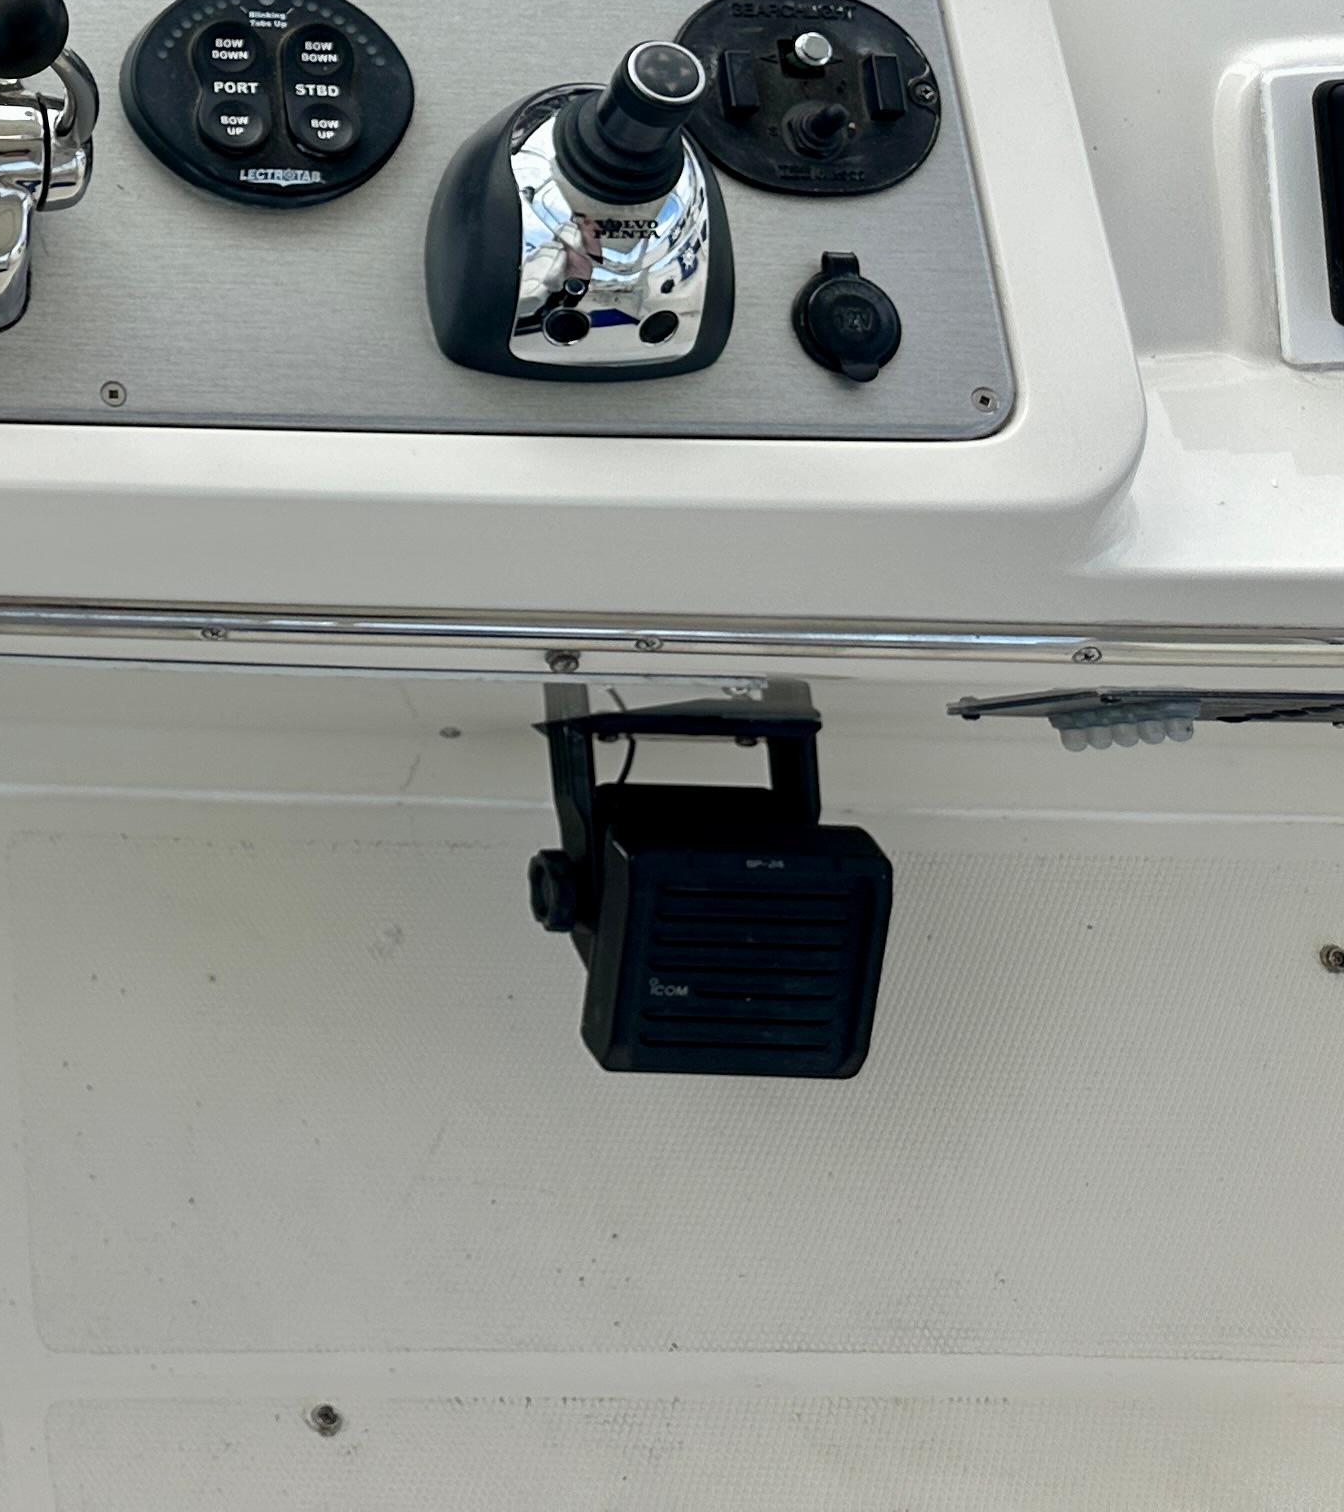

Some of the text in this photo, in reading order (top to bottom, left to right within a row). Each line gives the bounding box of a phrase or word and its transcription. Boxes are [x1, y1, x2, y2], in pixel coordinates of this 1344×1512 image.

[248, 11, 286, 21] Blinking
[274, 20, 288, 31] Up
[215, 38, 244, 49] BOW
[304, 41, 333, 52] BOW
[211, 49, 249, 61] DOWN
[301, 52, 338, 64] DOWN
[213, 81, 260, 95] PORT
[295, 84, 341, 98] STBD
[220, 116, 249, 127] BOW
[310, 119, 340, 130] BOW
[226, 127, 244, 137] UP
[316, 131, 336, 141] UP
[239, 169, 324, 186] LECTROTAB
[593, 219, 659, 230] VOLVO
[593, 229, 661, 240] PENTA
